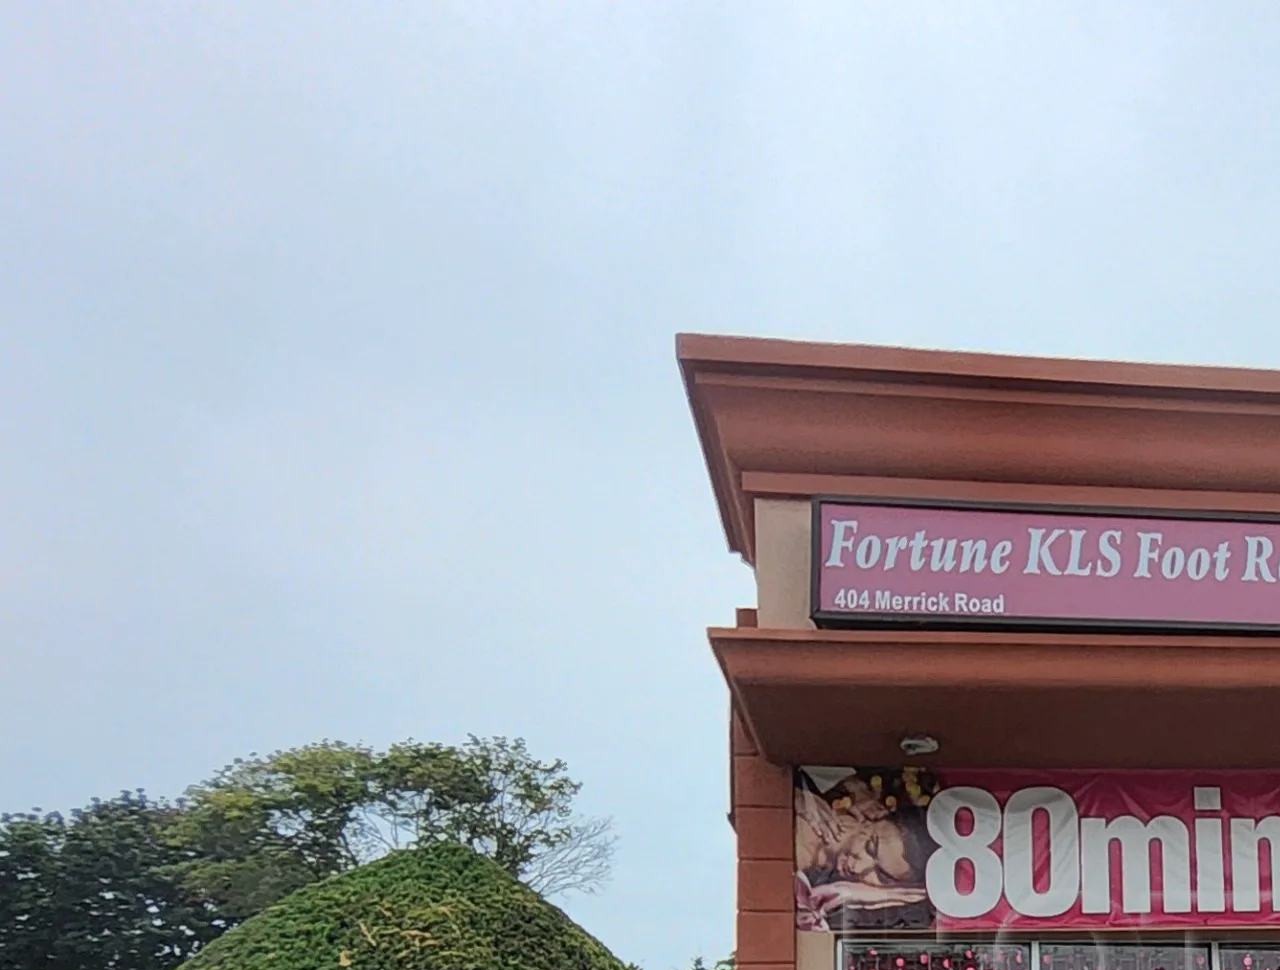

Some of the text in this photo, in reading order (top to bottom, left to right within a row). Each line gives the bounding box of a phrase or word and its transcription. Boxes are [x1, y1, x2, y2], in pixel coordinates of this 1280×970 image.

[825, 519, 1011, 574] Fortune
[1023, 527, 1122, 577] KLS
[1133, 531, 1231, 582] Foot
[834, 588, 1005, 614] 404 Merrick Road
